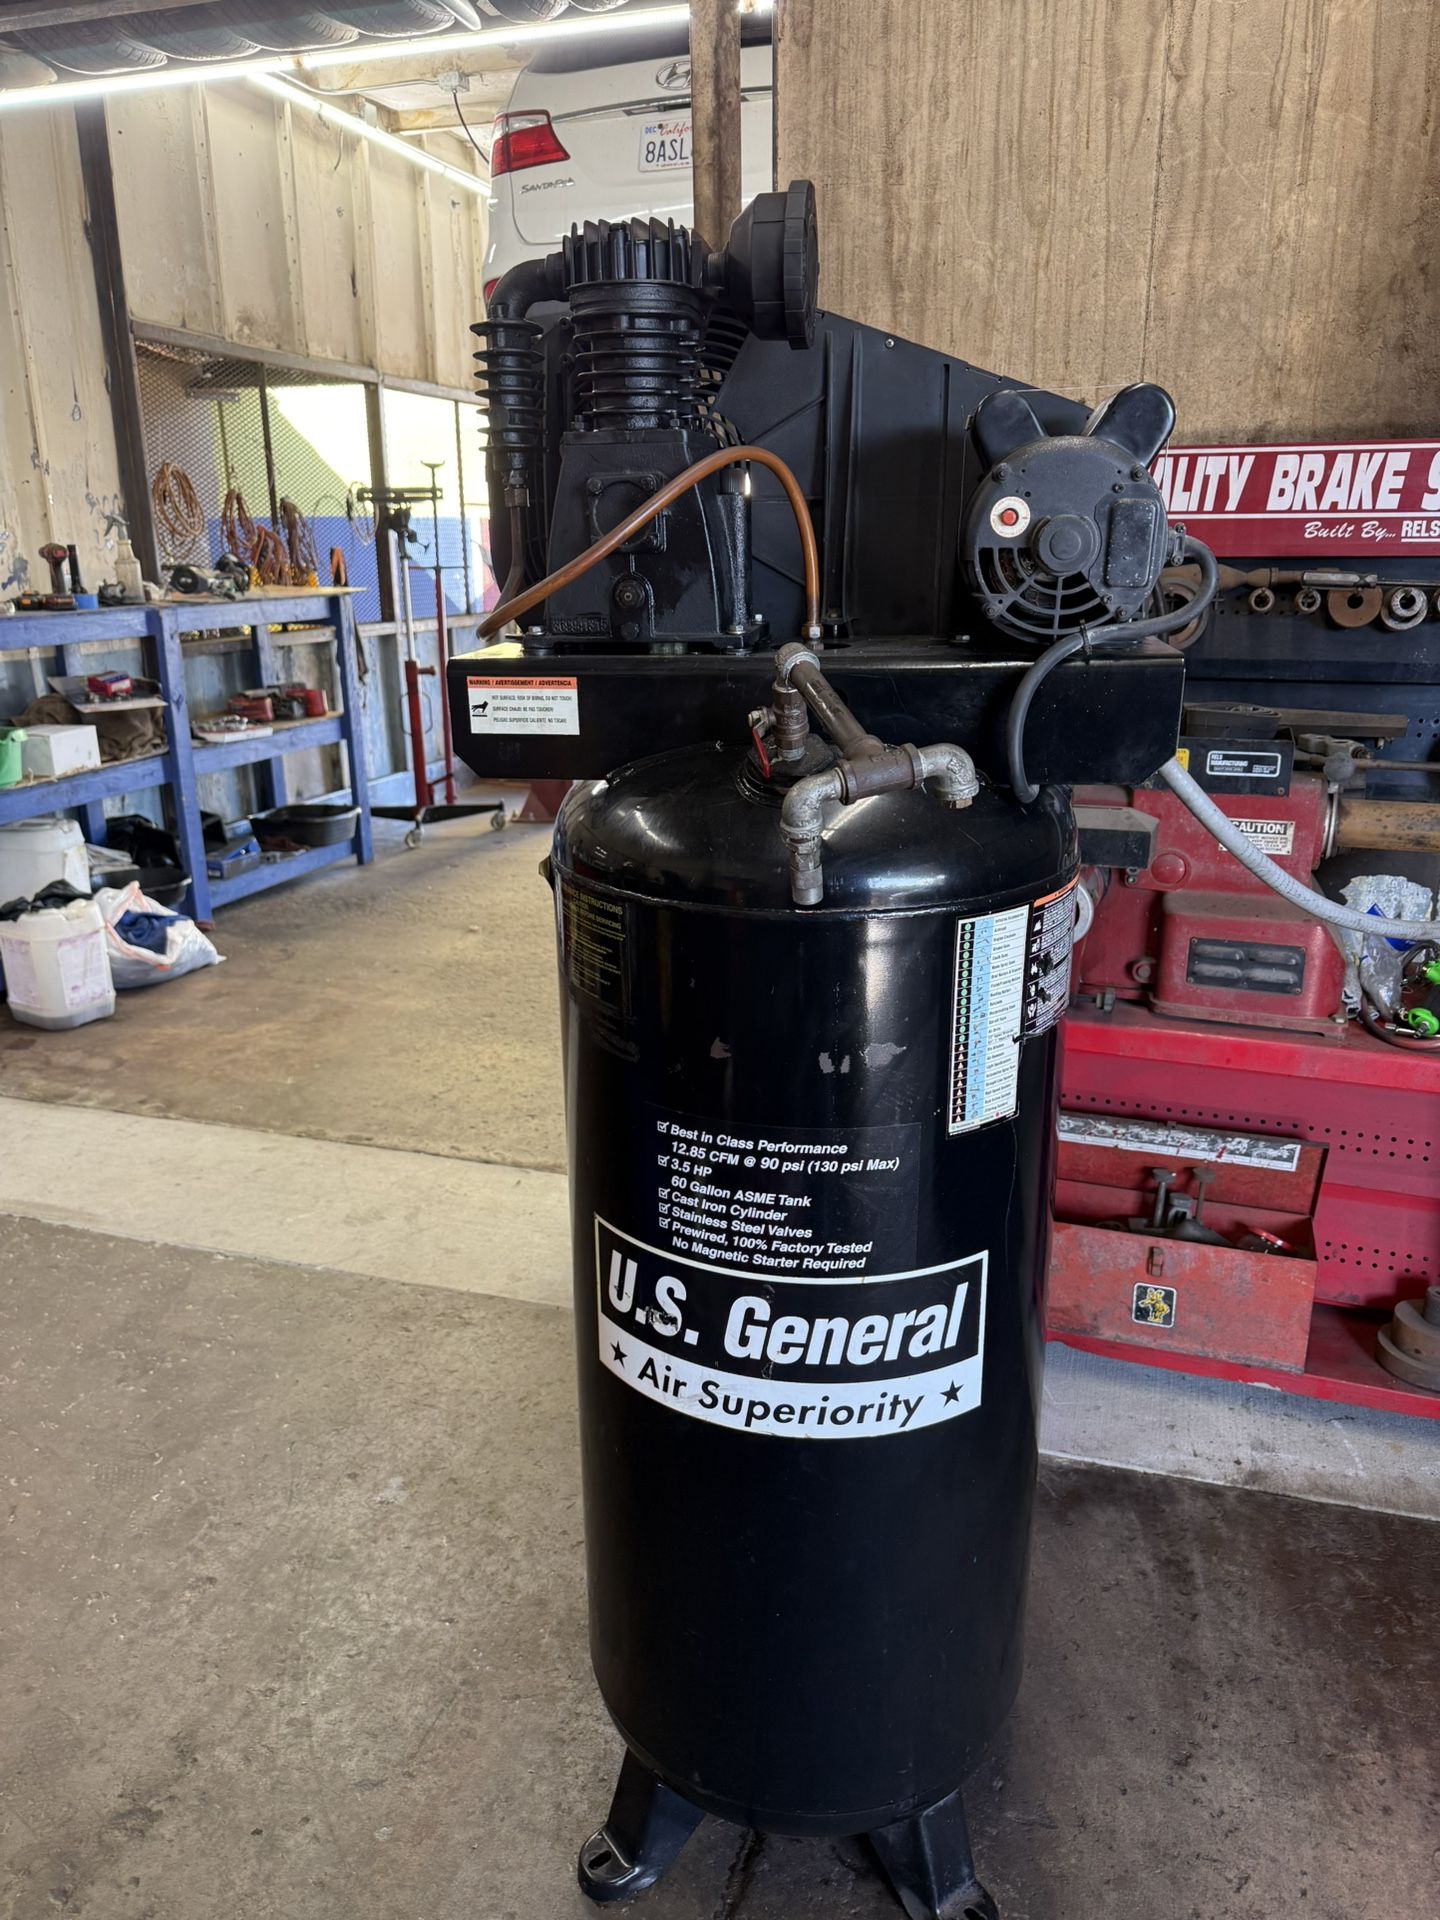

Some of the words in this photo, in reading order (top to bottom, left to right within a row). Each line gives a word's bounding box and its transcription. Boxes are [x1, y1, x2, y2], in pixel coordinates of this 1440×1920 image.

[645, 126, 657, 135] DEC
[645, 137, 693, 164] 8ASL
[1148, 455, 1256, 512] ALITY
[1266, 451, 1411, 512] BRAKE
[1303, 520, 1355, 539] Built
[671, 1124, 698, 1139] Best
[701, 1130, 713, 1143] in
[716, 1133, 754, 1150] Class
[758, 1139, 848, 1155] Performance
[671, 1141, 706, 1159] 12.85
[709, 1151, 739, 1165] CFM
[743, 1156, 757, 1168] @
[760, 1158, 779, 1170] 90
[781, 1159, 804, 1173] psi
[807, 1159, 838, 1174] (130
[841, 1159, 864, 1173] psi
[866, 1158, 899, 1171] Max)
[671, 1159, 690, 1171] 3.5
[694, 1166, 712, 1177] HP
[671, 1176, 687, 1188] 60
[689, 1180, 731, 1199] Gallon
[734, 1189, 776, 1204] ASME
[779, 1194, 811, 1207] Tank
[672, 1192, 698, 1205] Cast
[701, 1198, 727, 1212] Iron
[730, 1203, 788, 1221] Cylinder
[672, 1207, 728, 1228] Stainless
[731, 1219, 766, 1233] Steel
[768, 1226, 812, 1238] Valves
[672, 1222, 729, 1246] Prewired,
[732, 1236, 768, 1250] 100%
[771, 1240, 824, 1256] Factory
[826, 1241, 872, 1253] Tested
[672, 1237, 688, 1248] No
[691, 1242, 749, 1262] Magnetic
[752, 1255, 798, 1269] Starter
[802, 1257, 866, 1270] Required
[609, 1250, 699, 1345] U.S.
[724, 1281, 968, 1365] General
[637, 1357, 687, 1398] Air
[698, 1379, 925, 1427] Superiority
